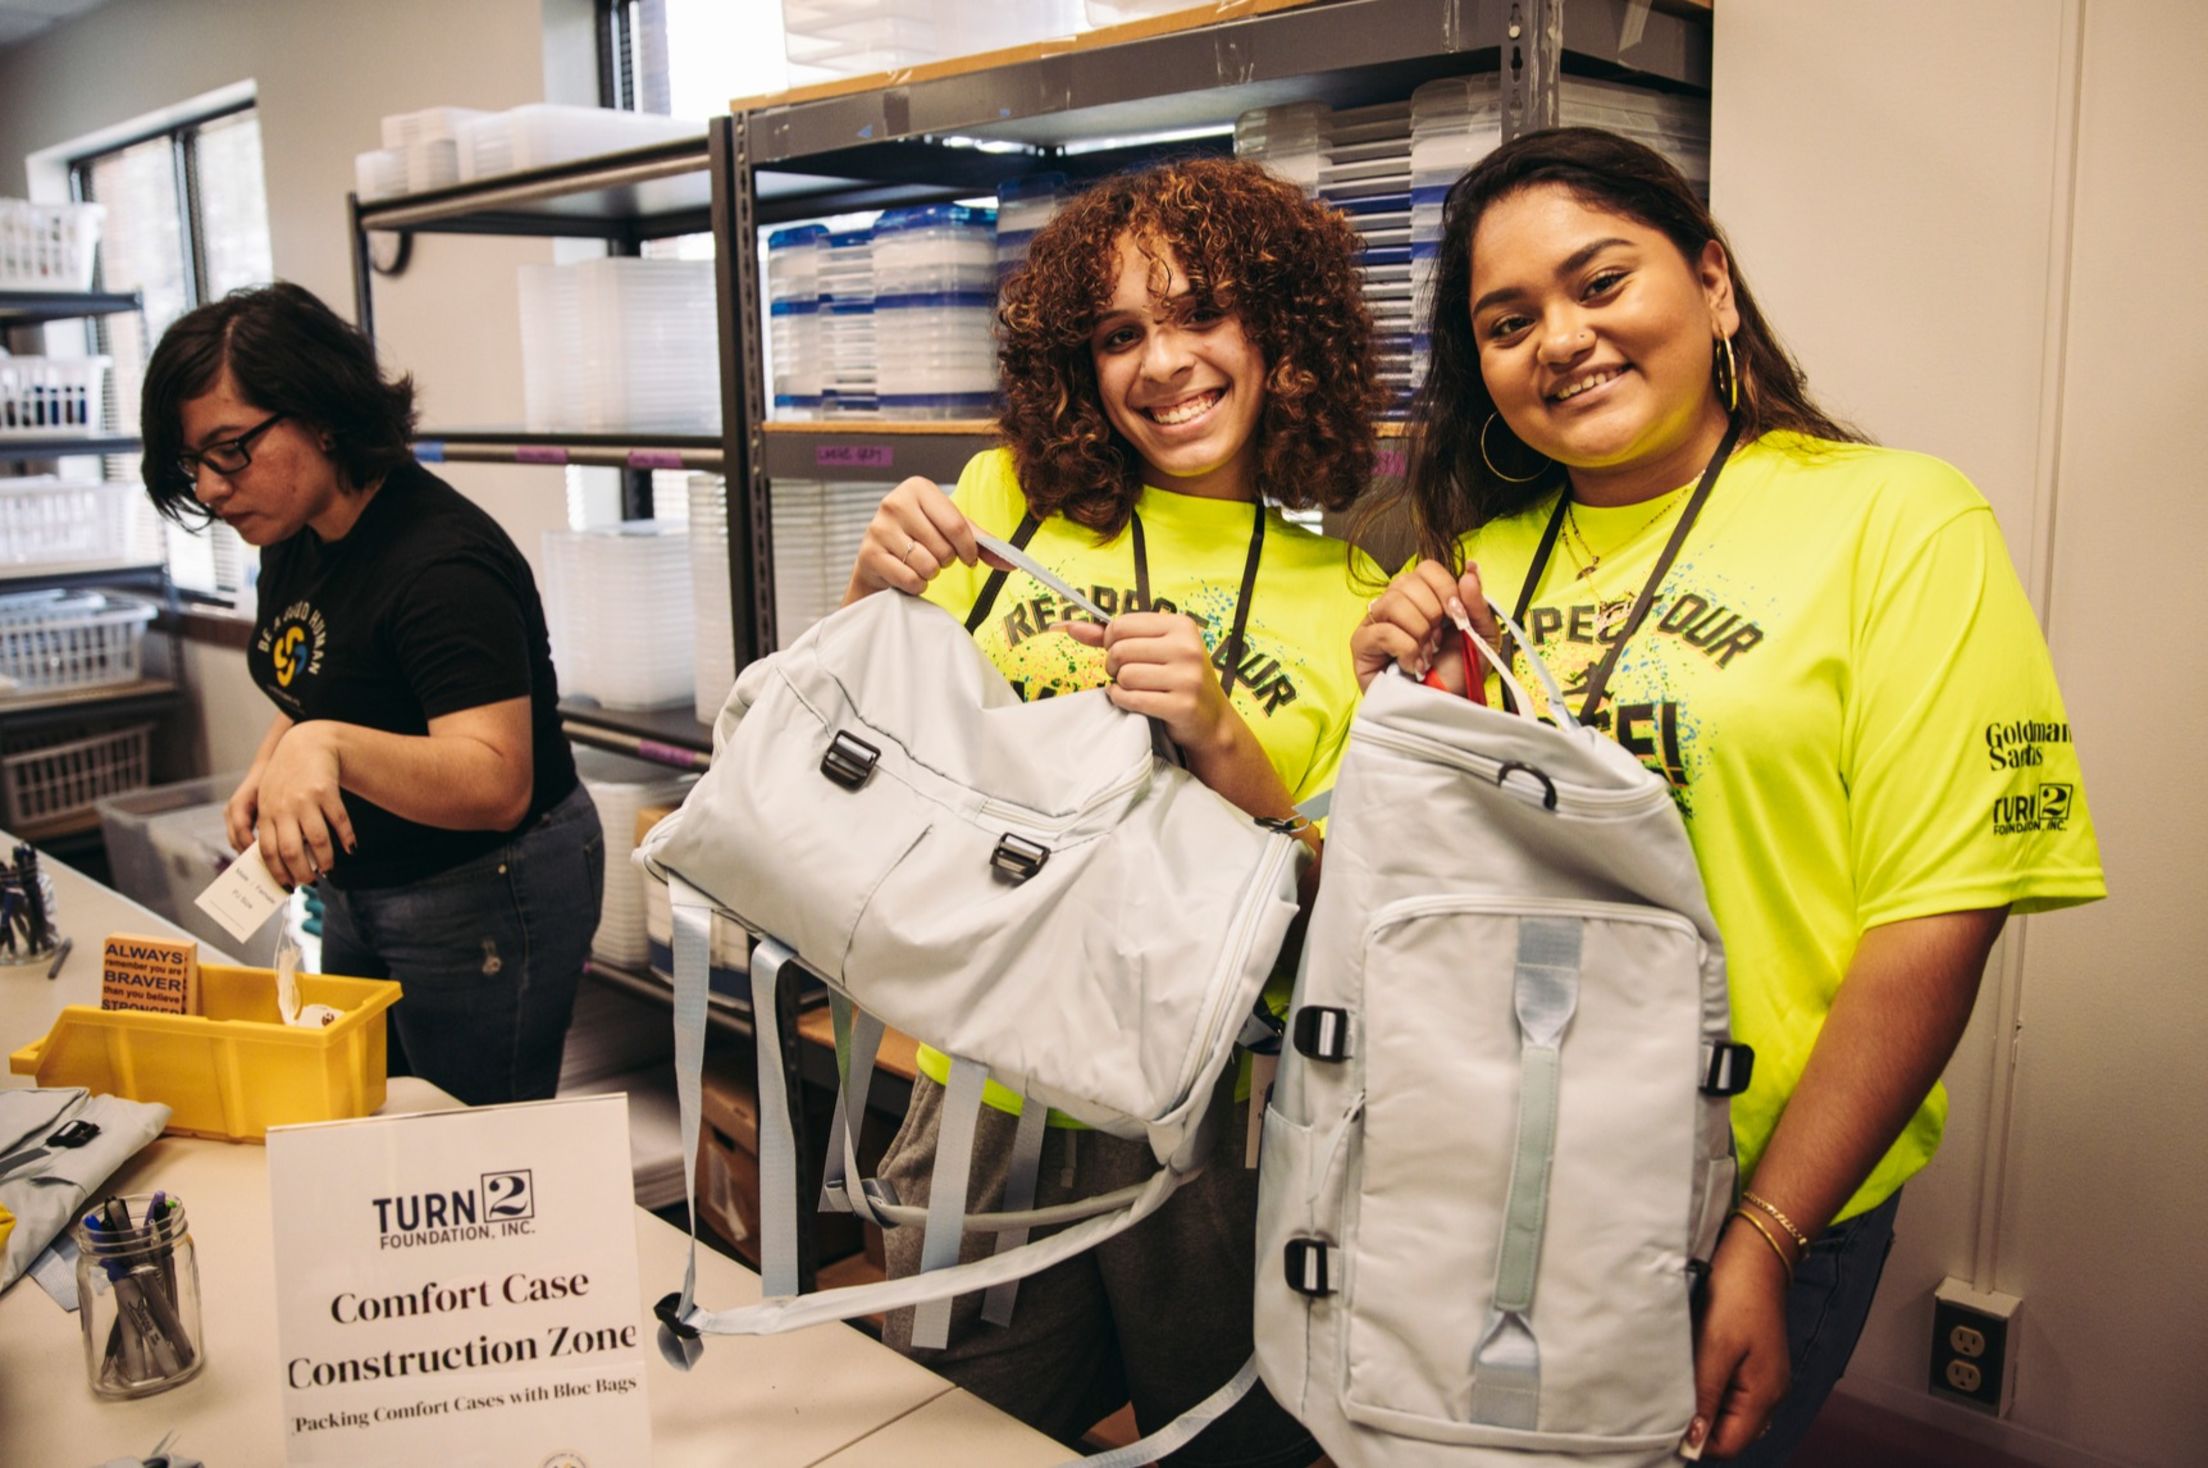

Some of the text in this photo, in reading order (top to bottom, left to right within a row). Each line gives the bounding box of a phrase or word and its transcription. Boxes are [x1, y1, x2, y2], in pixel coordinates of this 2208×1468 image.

[2042, 786, 2067, 817] 2
[105, 943, 183, 965] ALWAYS
[105, 959, 182, 976] remember you are
[104, 969, 182, 992] BRAVER
[103, 985, 180, 1004] than you believe
[372, 1175, 529, 1234] TURN 2
[501, 1220, 536, 1237] INC.
[330, 1271, 589, 1324] Comfort Case
[288, 1324, 637, 1390] Construction Zone
[293, 1376, 637, 1434] Packing Comfort Cases with Bloc Bags
